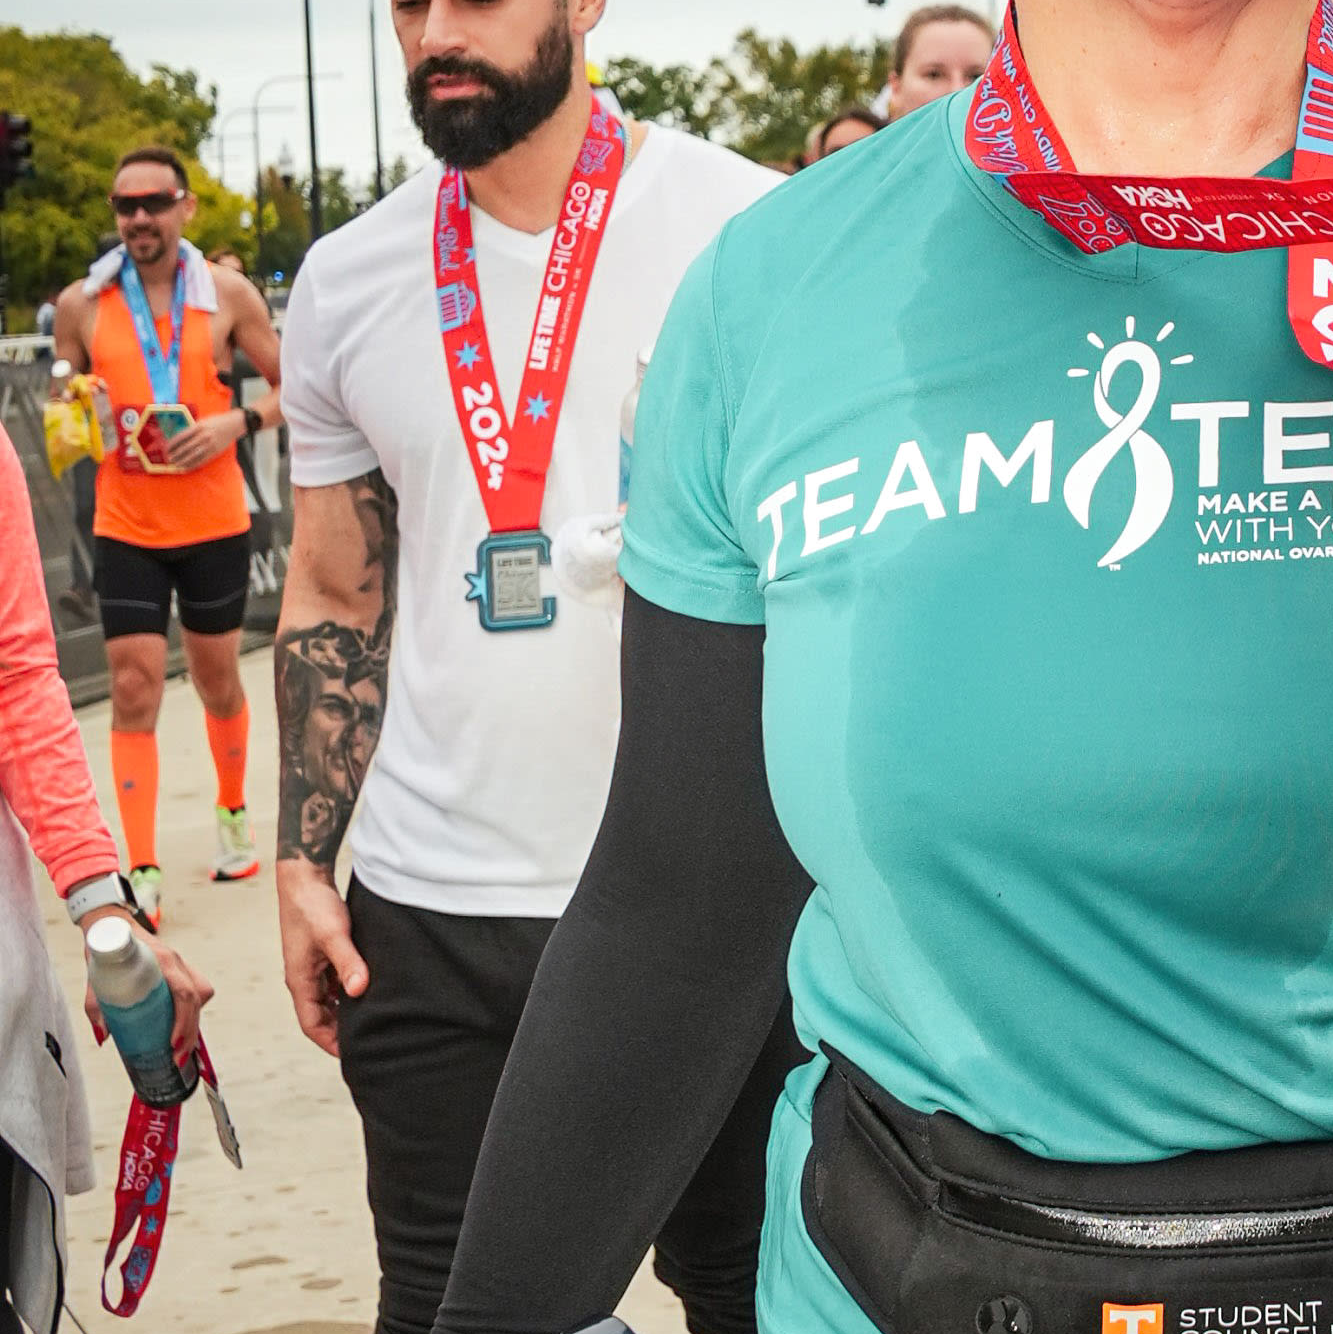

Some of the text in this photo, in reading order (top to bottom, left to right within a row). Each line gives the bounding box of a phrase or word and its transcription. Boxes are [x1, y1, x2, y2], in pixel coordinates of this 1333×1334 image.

[1016, 83, 1036, 123] CITY
[583, 188, 609, 231] HOKA
[1112, 185, 1193, 211] HOKA
[1262, 191, 1287, 203] 5K
[546, 181, 591, 292] CHICAGO
[461, 382, 509, 491] 2024
[757, 419, 1054, 581] TEAM
[1198, 491, 1289, 516] MAKE
[1298, 489, 1323, 511] A
[1195, 517, 1294, 545] WITH
[1197, 548, 1282, 565] NATIONAL
[121, 1149, 138, 1191] HOKA
[134, 1109, 168, 1191] HICAGO
[1179, 1300, 1323, 1328] STUDENT
